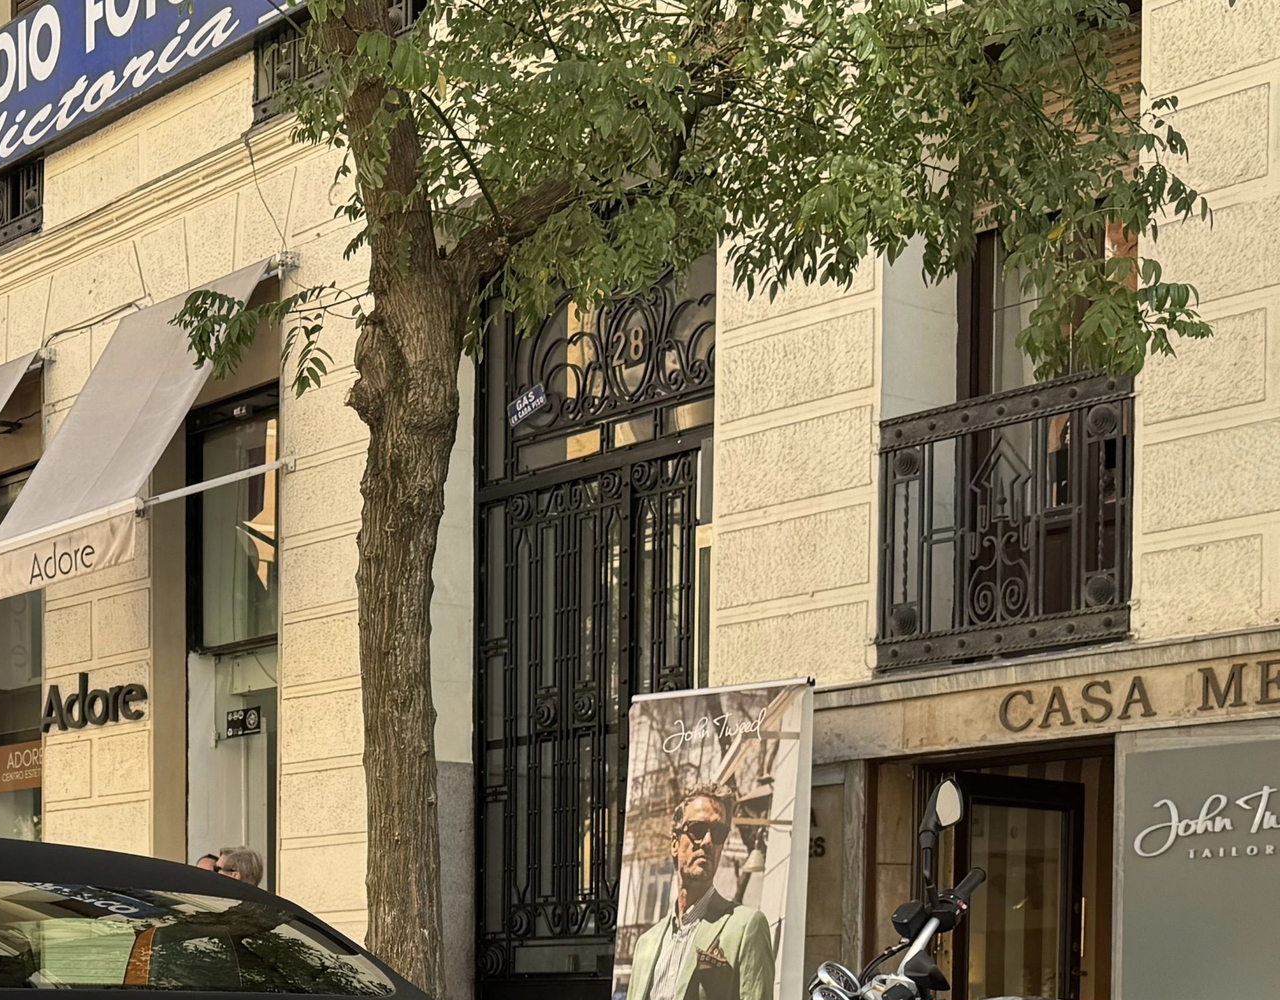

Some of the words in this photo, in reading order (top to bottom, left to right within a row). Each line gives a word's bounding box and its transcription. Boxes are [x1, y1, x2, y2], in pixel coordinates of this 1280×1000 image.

[612, 325, 644, 368] 28
[516, 391, 535, 411] GAS
[29, 541, 95, 585] Adore
[39, 672, 148, 733] Adore
[998, 675, 1157, 732] CASA
[662, 716, 709, 753] John
[713, 707, 767, 740] Tweed
[1, 770, 24, 782] CENTRO
[6, 747, 43, 770] ADORE
[1133, 793, 1233, 857] John
[1188, 844, 1275, 859] TAILOR
